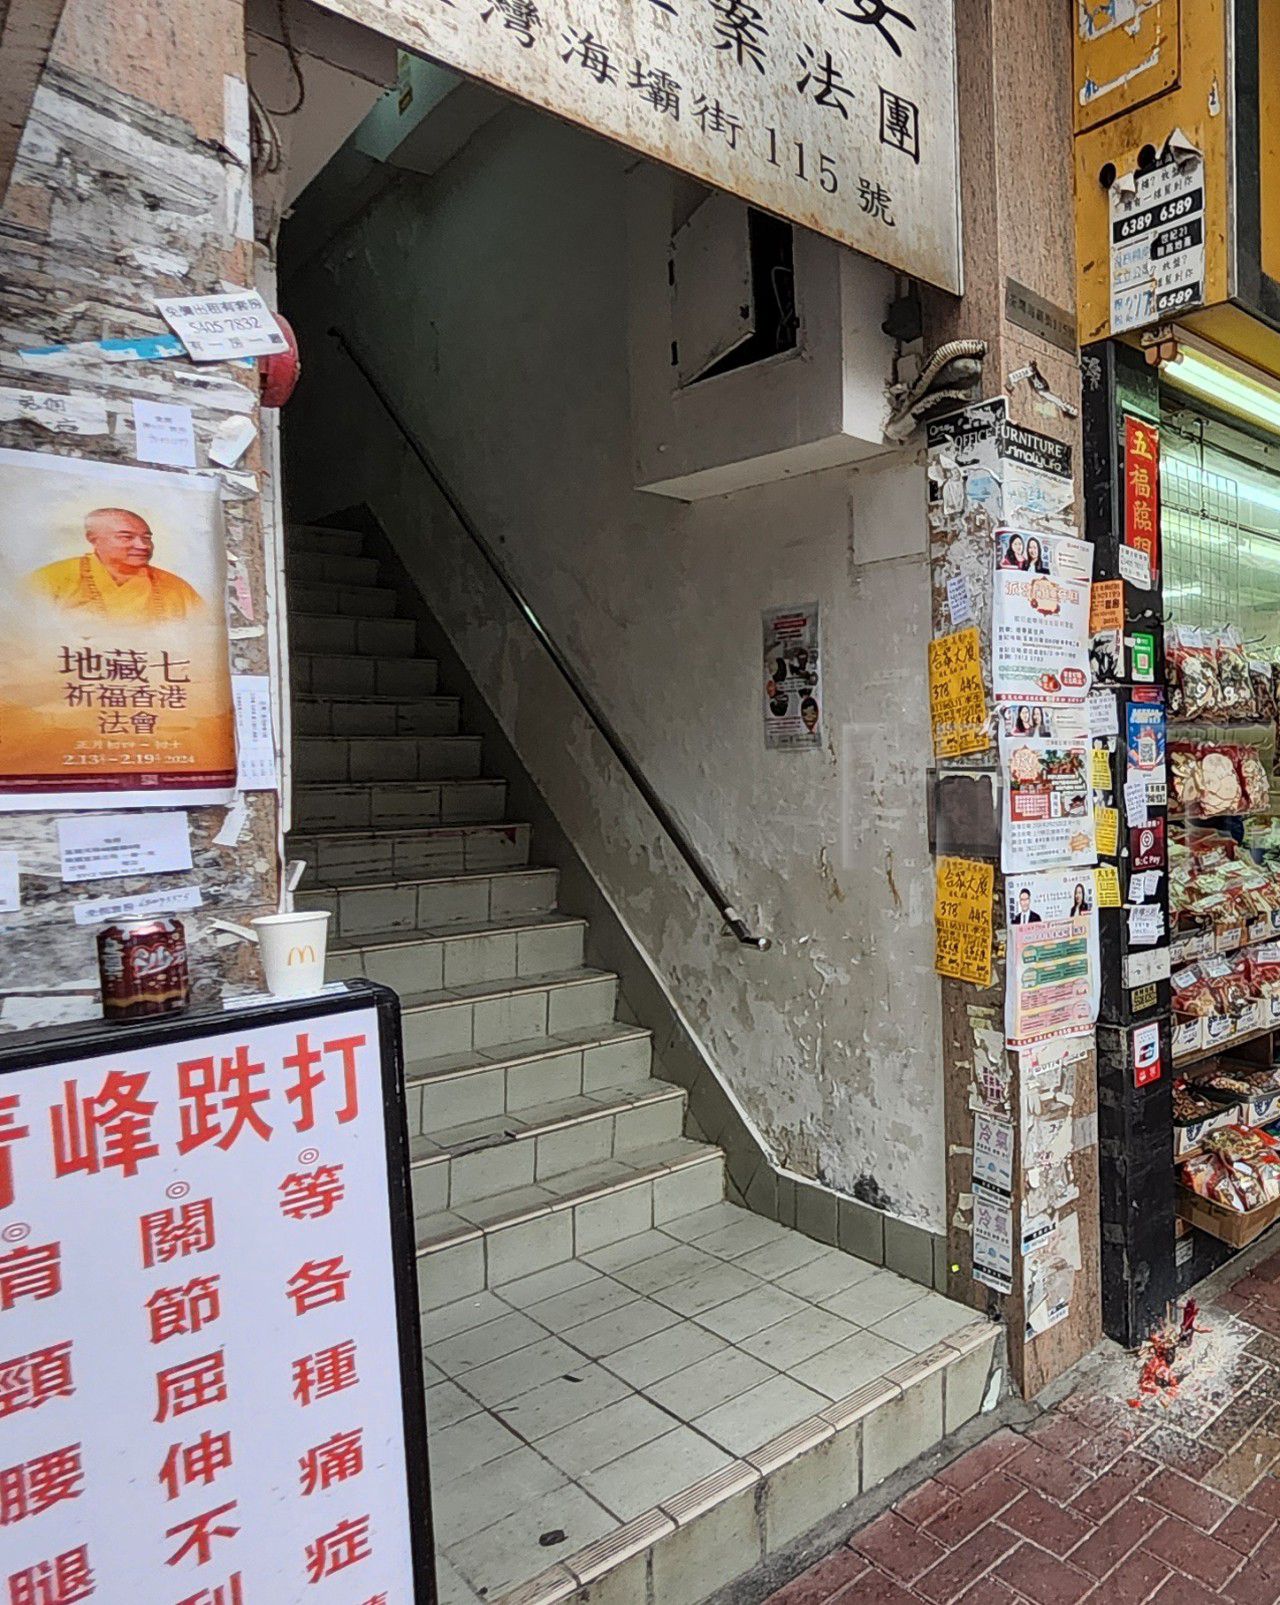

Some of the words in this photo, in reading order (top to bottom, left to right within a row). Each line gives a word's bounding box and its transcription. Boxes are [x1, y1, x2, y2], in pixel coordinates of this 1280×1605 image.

[655, 0, 920, 165] 案法團
[1121, 212, 1153, 237] 6389
[1159, 196, 1192, 222] 6589
[1158, 287, 1193, 309] 6589
[224, 315, 263, 332] 7832
[955, 427, 993, 447] OFFICE
[995, 424, 1064, 459] FURNITURE
[58, 646, 191, 684] 地藏七
[62, 682, 189, 709] 祈福香港
[98, 709, 159, 735] 法會
[139, 1197, 246, 1605] 關節屈伸不
